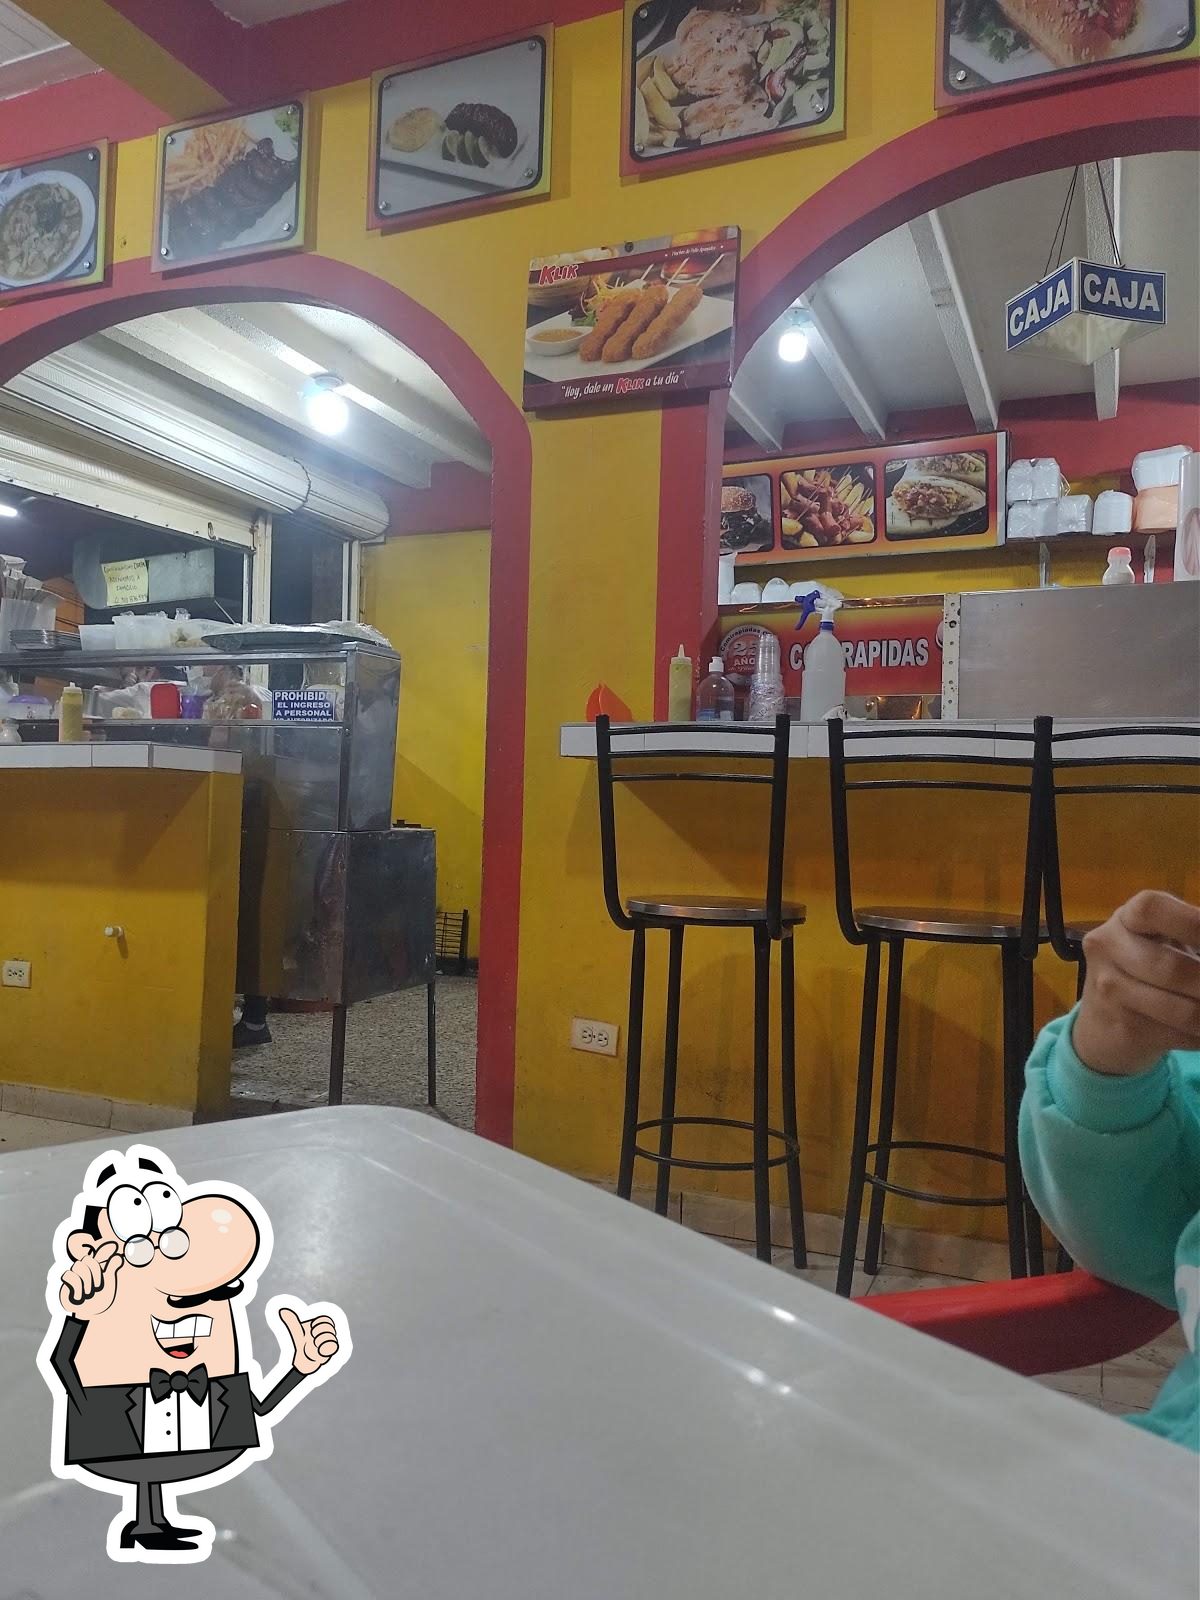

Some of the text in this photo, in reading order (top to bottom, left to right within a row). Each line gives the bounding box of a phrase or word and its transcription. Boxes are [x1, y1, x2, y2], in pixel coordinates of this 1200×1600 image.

[539, 264, 579, 287] KLIK
[1083, 273, 1160, 312] CAJA
[1009, 278, 1070, 337] CAJA
[584, 382, 601, 396] dale
[602, 382, 614, 393] un
[616, 377, 644, 394] KLIK
[645, 379, 651, 387] a
[653, 375, 664, 387] tu
[790, 638, 929, 671] CRAPIDAS
[291, 701, 331, 709] INGRESO
